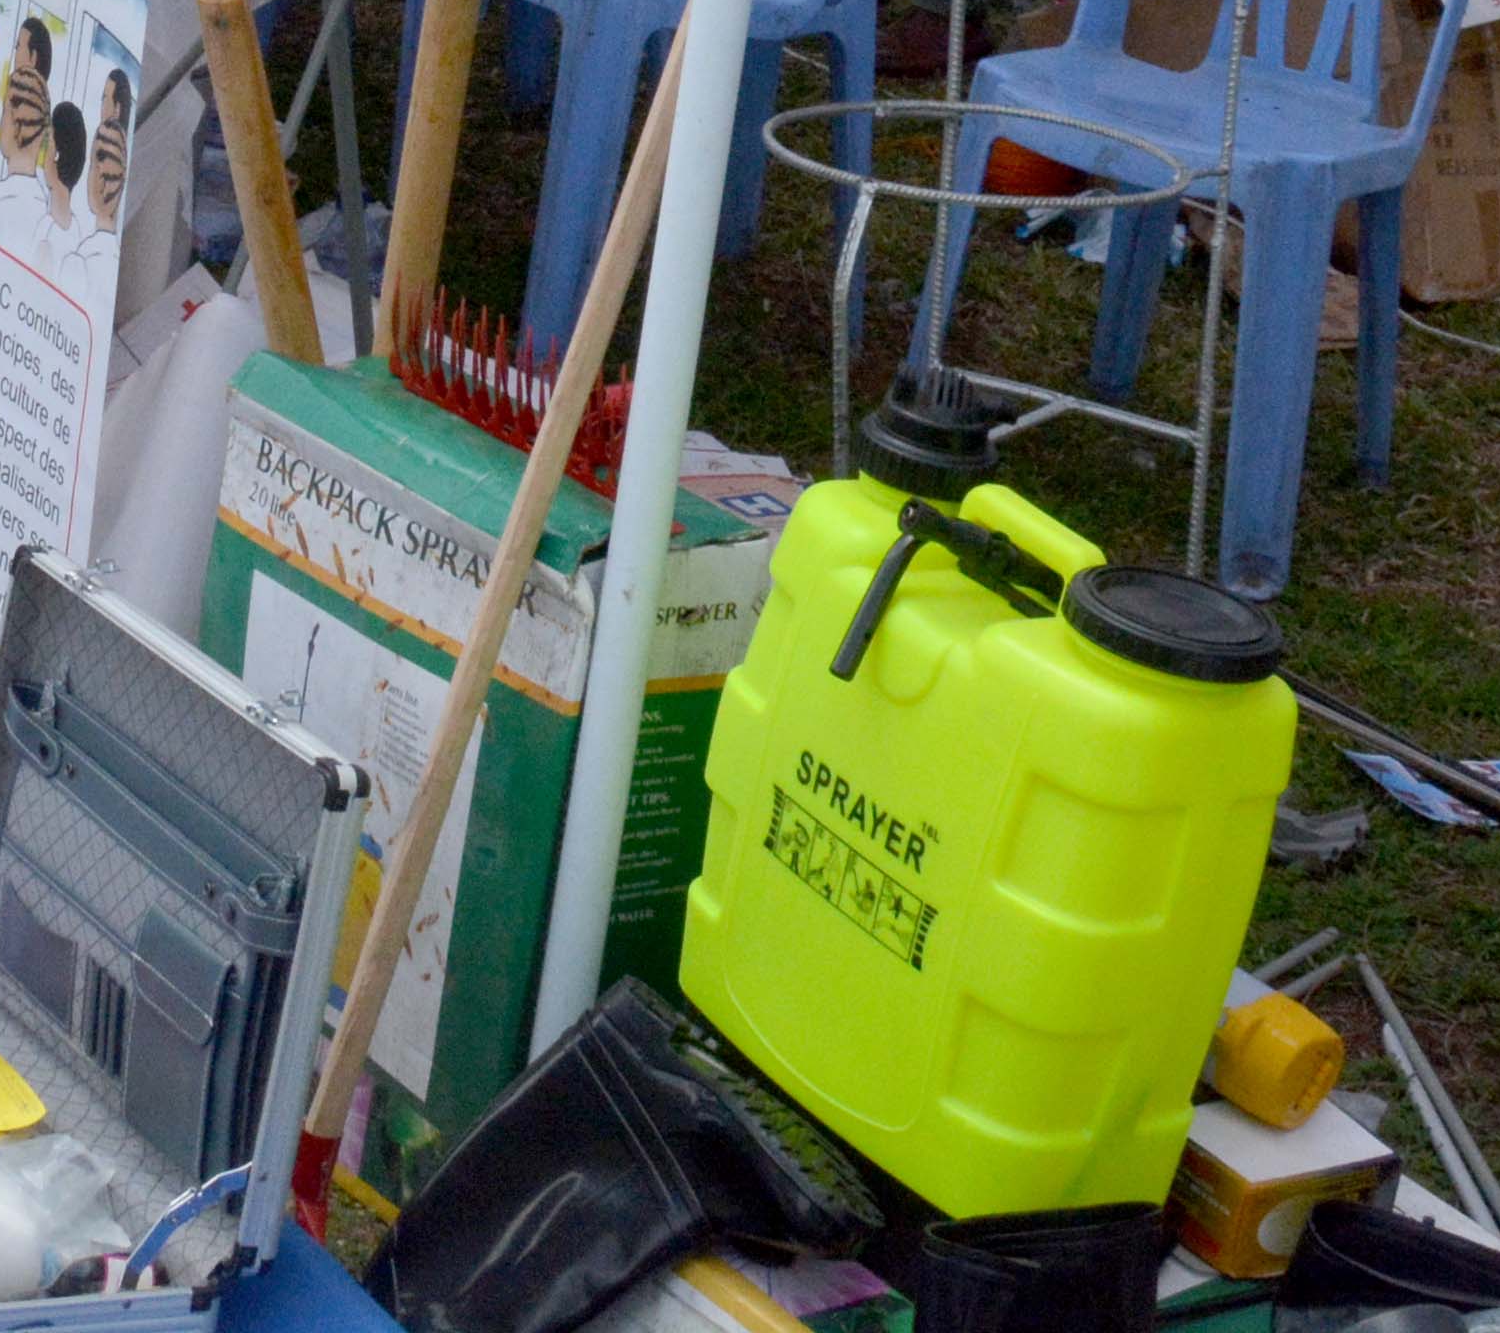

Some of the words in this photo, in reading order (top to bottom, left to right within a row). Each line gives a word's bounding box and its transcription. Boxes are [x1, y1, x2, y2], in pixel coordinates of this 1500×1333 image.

[17, 300, 80, 365] contribue
[50, 369, 76, 406] des
[0, 376, 49, 427] culture
[52, 415, 71, 445] de
[39, 449, 65, 486] des
[248, 481, 269, 508] 20
[30, 530, 56, 553] se
[256, 436, 400, 547] BACKPACK
[401, 520, 537, 618] SPRAR
[655, 601, 739, 627] SPRYER
[796, 749, 927, 874] SPRAYER
